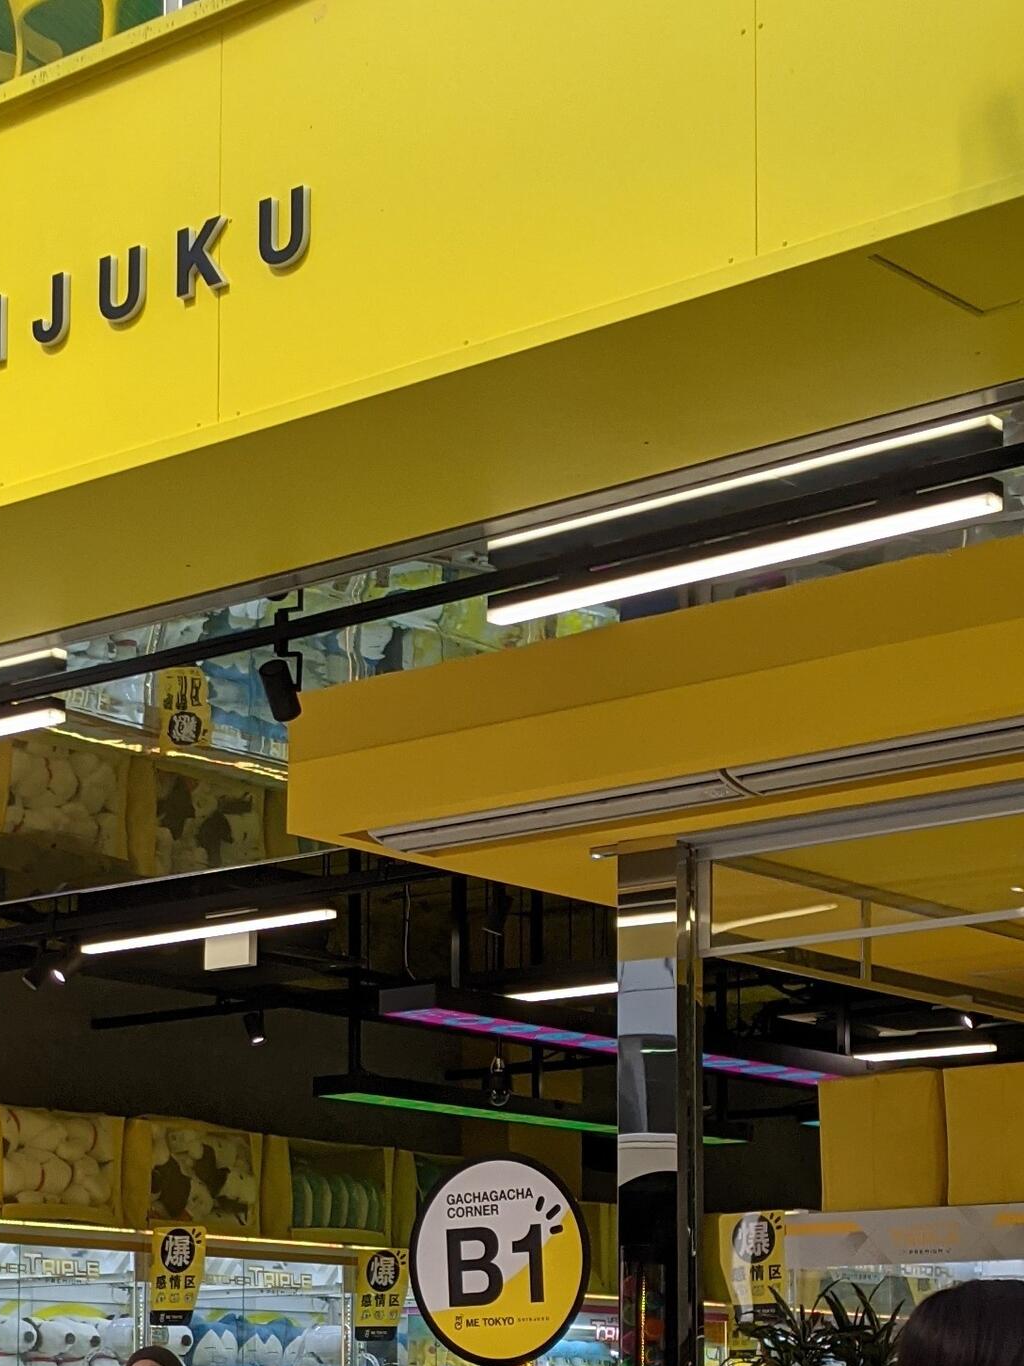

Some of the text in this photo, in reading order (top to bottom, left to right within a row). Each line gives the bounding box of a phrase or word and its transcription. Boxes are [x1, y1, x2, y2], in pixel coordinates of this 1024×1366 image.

[446, 1187, 534, 1206] GACHAGACHA
[447, 1203, 500, 1219] CORNER
[23, 1252, 100, 1281] TRIPLE
[446, 1223, 545, 1308] B1
[248, 1265, 313, 1289] TRIPLE
[466, 1318, 480, 1328] ME
[482, 1316, 515, 1327] TOKYO
